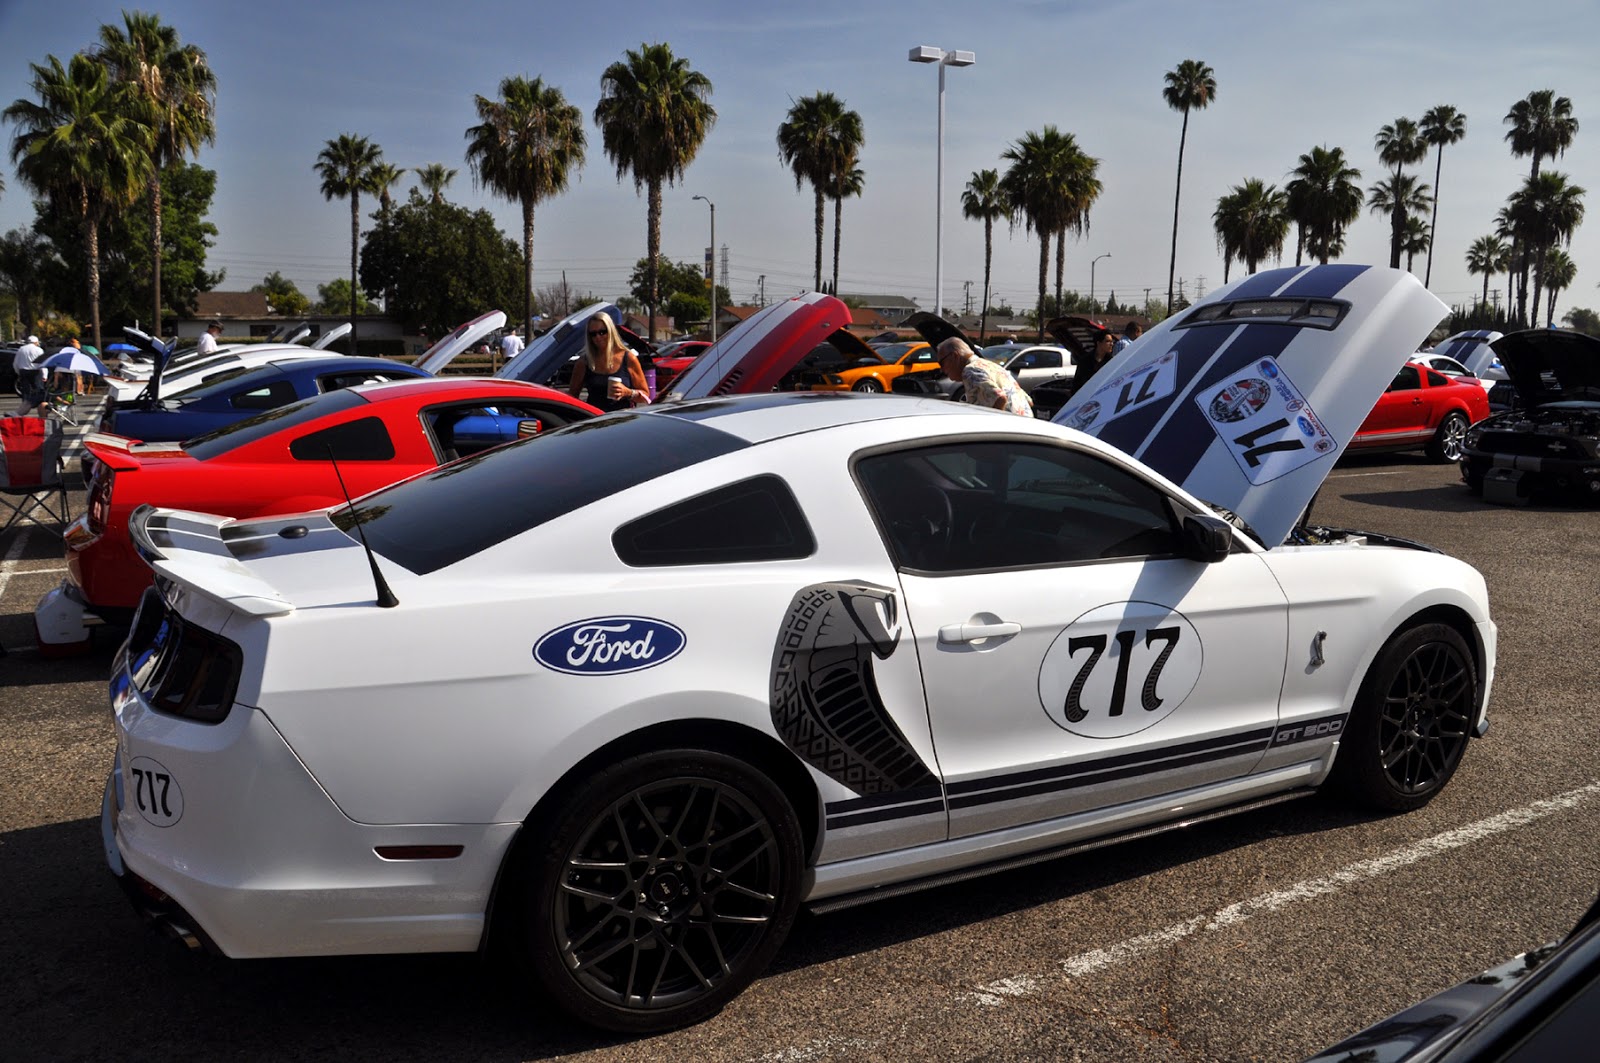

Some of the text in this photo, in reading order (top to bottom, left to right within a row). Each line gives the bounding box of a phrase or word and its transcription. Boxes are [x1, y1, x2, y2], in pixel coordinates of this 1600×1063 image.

[1275, 377, 1296, 401] AMERICAN
[1303, 408, 1327, 437] RACING
[566, 623, 655, 667] Ford
[1064, 626, 1181, 723] 717
[1276, 720, 1343, 742] GT 500
[131, 767, 173, 817] 717
